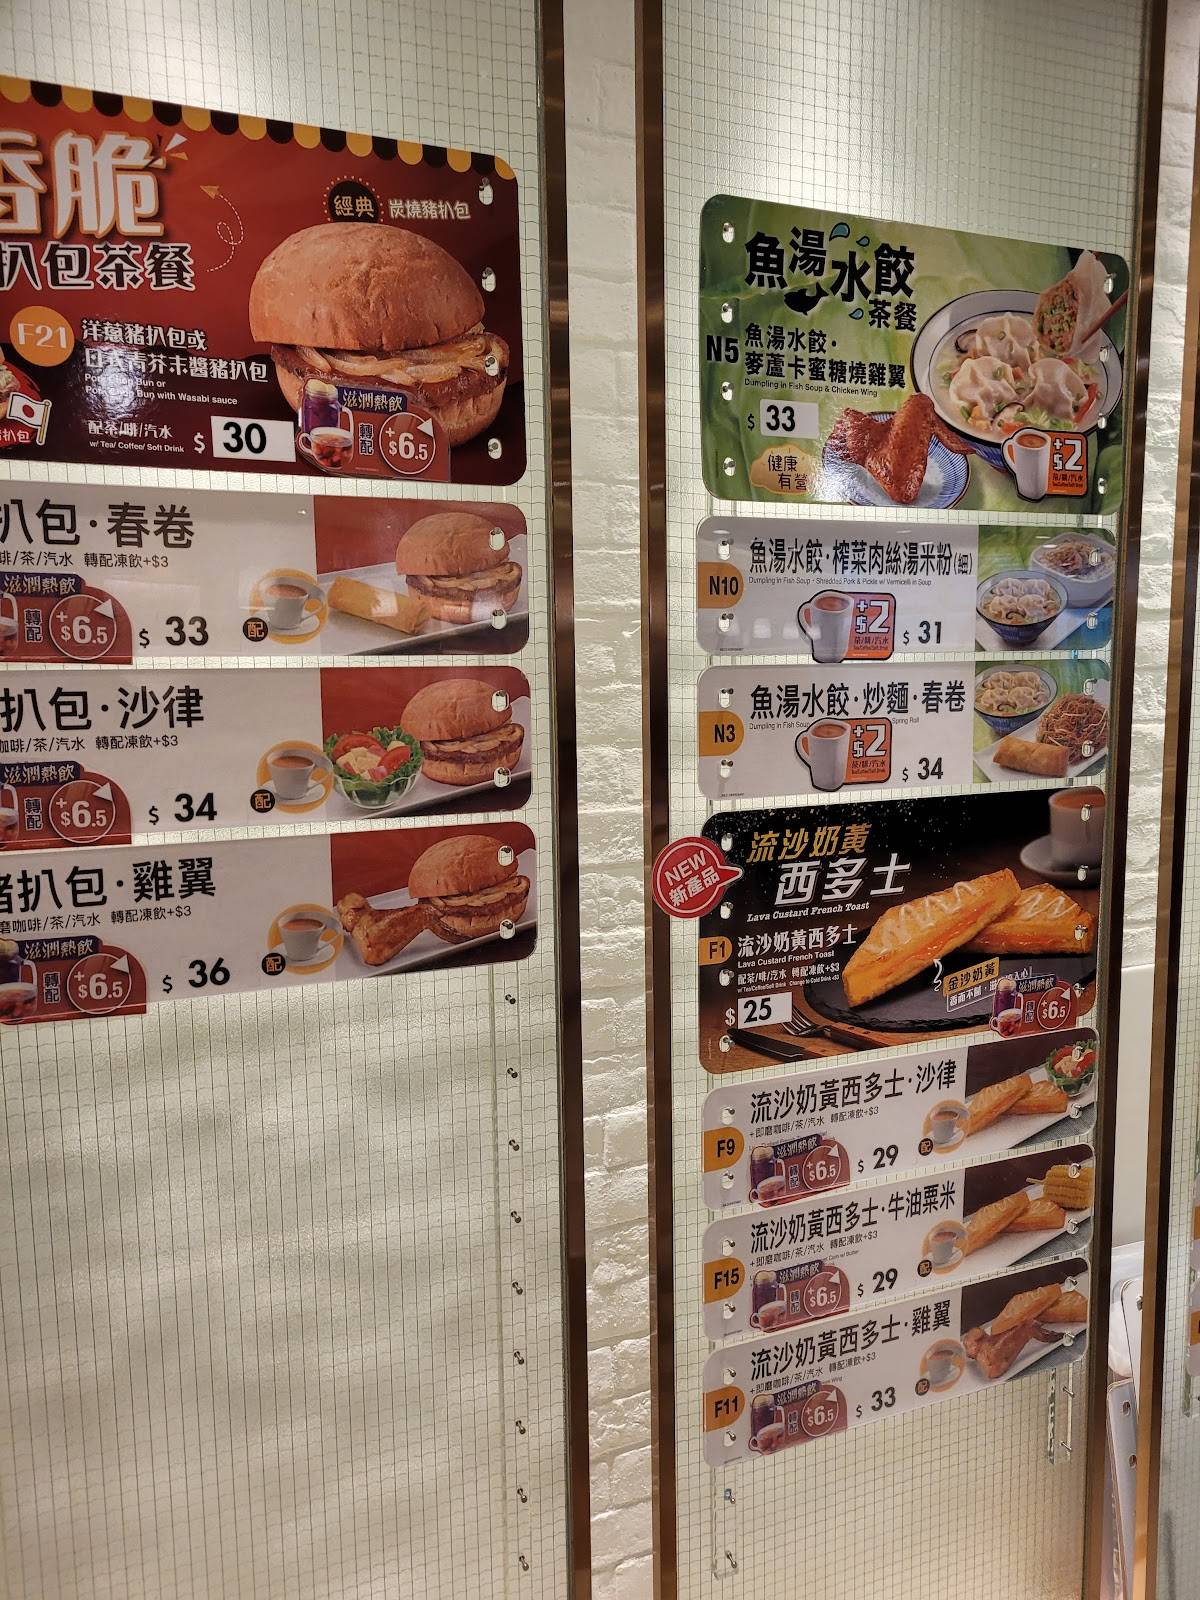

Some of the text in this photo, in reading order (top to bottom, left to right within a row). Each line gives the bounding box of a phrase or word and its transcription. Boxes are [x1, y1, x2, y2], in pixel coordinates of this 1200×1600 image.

[334, 195, 374, 218] 經典
[388, 198, 471, 220] 炭燒豬扒包
[744, 226, 915, 303] 魚湯水餃
[868, 298, 917, 332] 茶餐
[17, 323, 67, 348] F21
[706, 335, 739, 364] N5
[744, 351, 906, 389] 麥蘆卡蜜糖燒雞翼
[136, 377, 154, 387] Bun
[744, 378, 878, 398] Dumpling in Fish Soup & Chicken Wing
[137, 389, 155, 399] Bun
[157, 391, 176, 400] with
[178, 393, 210, 403] Wasabi
[212, 397, 237, 405] sauce
[342, 389, 403, 412] 滋潤熱飲
[747, 404, 796, 433] $ 33
[100, 440, 116, 449] Tea/
[118, 441, 146, 450] Coffee/
[147, 443, 163, 451] Soft
[164, 444, 184, 453] Drink
[193, 421, 267, 454] $ 30
[359, 423, 374, 455] 轉配
[768, 454, 798, 473] 健康
[778, 472, 808, 492] 有營
[84, 552, 169, 569] 轉配凍飲+$3
[4, 574, 76, 595] 滋潤熱飲
[709, 575, 739, 596] N10
[749, 576, 776, 585] Dumpling
[796, 577, 811, 585] Soup
[843, 577, 856, 585] Pork
[918, 578, 932, 586] Soup
[24, 607, 43, 643] 轉配
[139, 616, 209, 648] $ 33
[246, 622, 265, 638] 配
[903, 630, 910, 646] $
[918, 620, 943, 645] 31
[714, 724, 736, 744] N3
[749, 721, 776, 731] Dumpling
[783, 721, 795, 729] Fish
[892, 717, 909, 726] Spring
[910, 716, 920, 724] Roll
[95, 735, 179, 750] 轉配凍飲+$3
[3, 764, 75, 785] 滋潤熱飲
[902, 757, 944, 782] $ 34
[148, 793, 217, 825] $ 34
[254, 793, 272, 810] 配
[25, 797, 43, 831] 轉配
[746, 823, 872, 863] 流沙奶黃
[664, 850, 707, 887] NEW
[774, 853, 911, 906] 西多士
[668, 866, 721, 908] 新產品
[111, 905, 192, 925] 轉配凍飲+$3
[746, 901, 870, 923] Lava Custard French Toast
[24, 939, 94, 960] 滋潤熱飲
[709, 941, 726, 960] F1
[737, 924, 858, 958] 流沙奶黃西多士
[265, 956, 283, 973] 配
[737, 950, 835, 969] Lava Custard French Toast
[163, 957, 230, 994] $ 36
[949, 962, 995, 991] 金沙奶黃
[43, 971, 61, 1004] 轉配
[725, 997, 772, 1026] $ 25
[717, 1138, 736, 1158] F9
[857, 1144, 899, 1173] $ 29
[920, 1140, 932, 1154] 配
[789, 1165, 800, 1189] 轉配
[714, 1269, 740, 1290] F15
[919, 1262, 931, 1275] 配
[857, 1268, 899, 1298] $ 29
[714, 1395, 739, 1418] F11
[855, 1386, 896, 1419] $ 33
